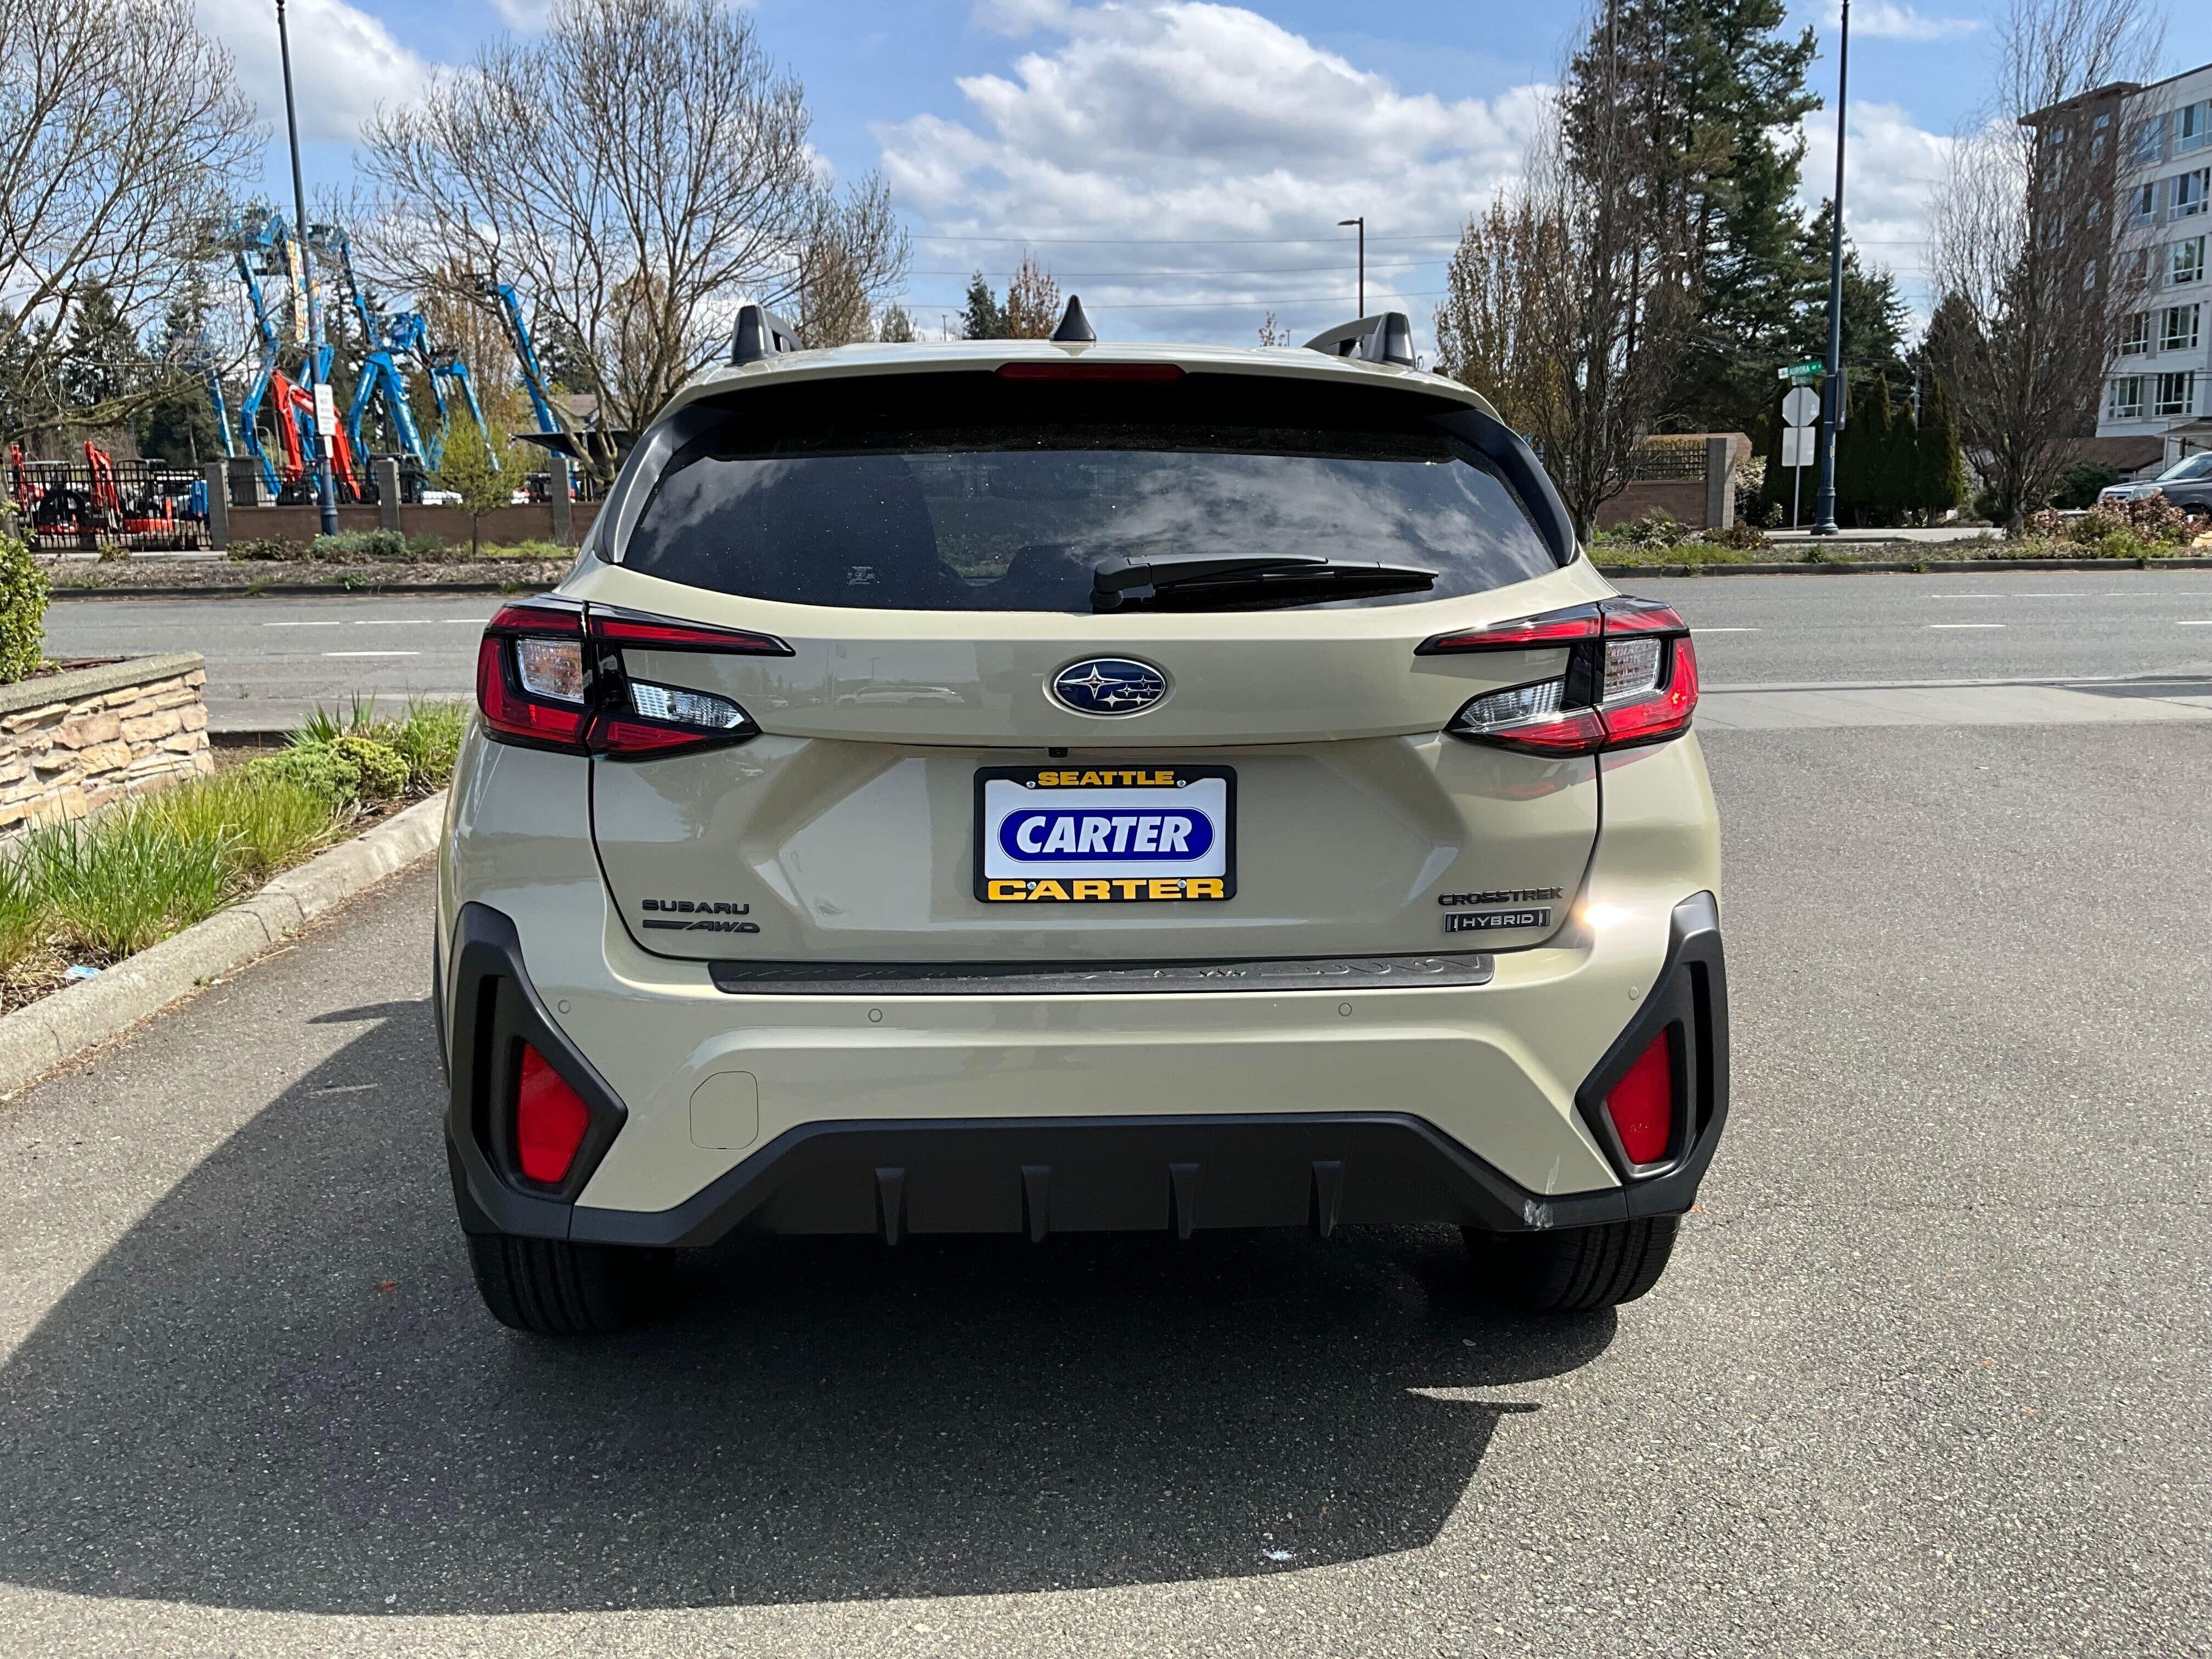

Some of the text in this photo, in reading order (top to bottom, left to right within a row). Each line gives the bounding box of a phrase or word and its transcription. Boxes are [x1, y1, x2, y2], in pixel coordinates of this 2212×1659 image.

[1789, 365, 1810, 375] AURORA
[1037, 771, 1175, 786] SEATTLE
[1016, 816, 1193, 853] CARTER
[988, 879, 1224, 901] CARTER
[1438, 887, 1564, 906] CROSSTREK
[642, 899, 750, 915] SUBARU
[686, 920, 760, 933] AWD
[1462, 913, 1534, 927] HYBRID
